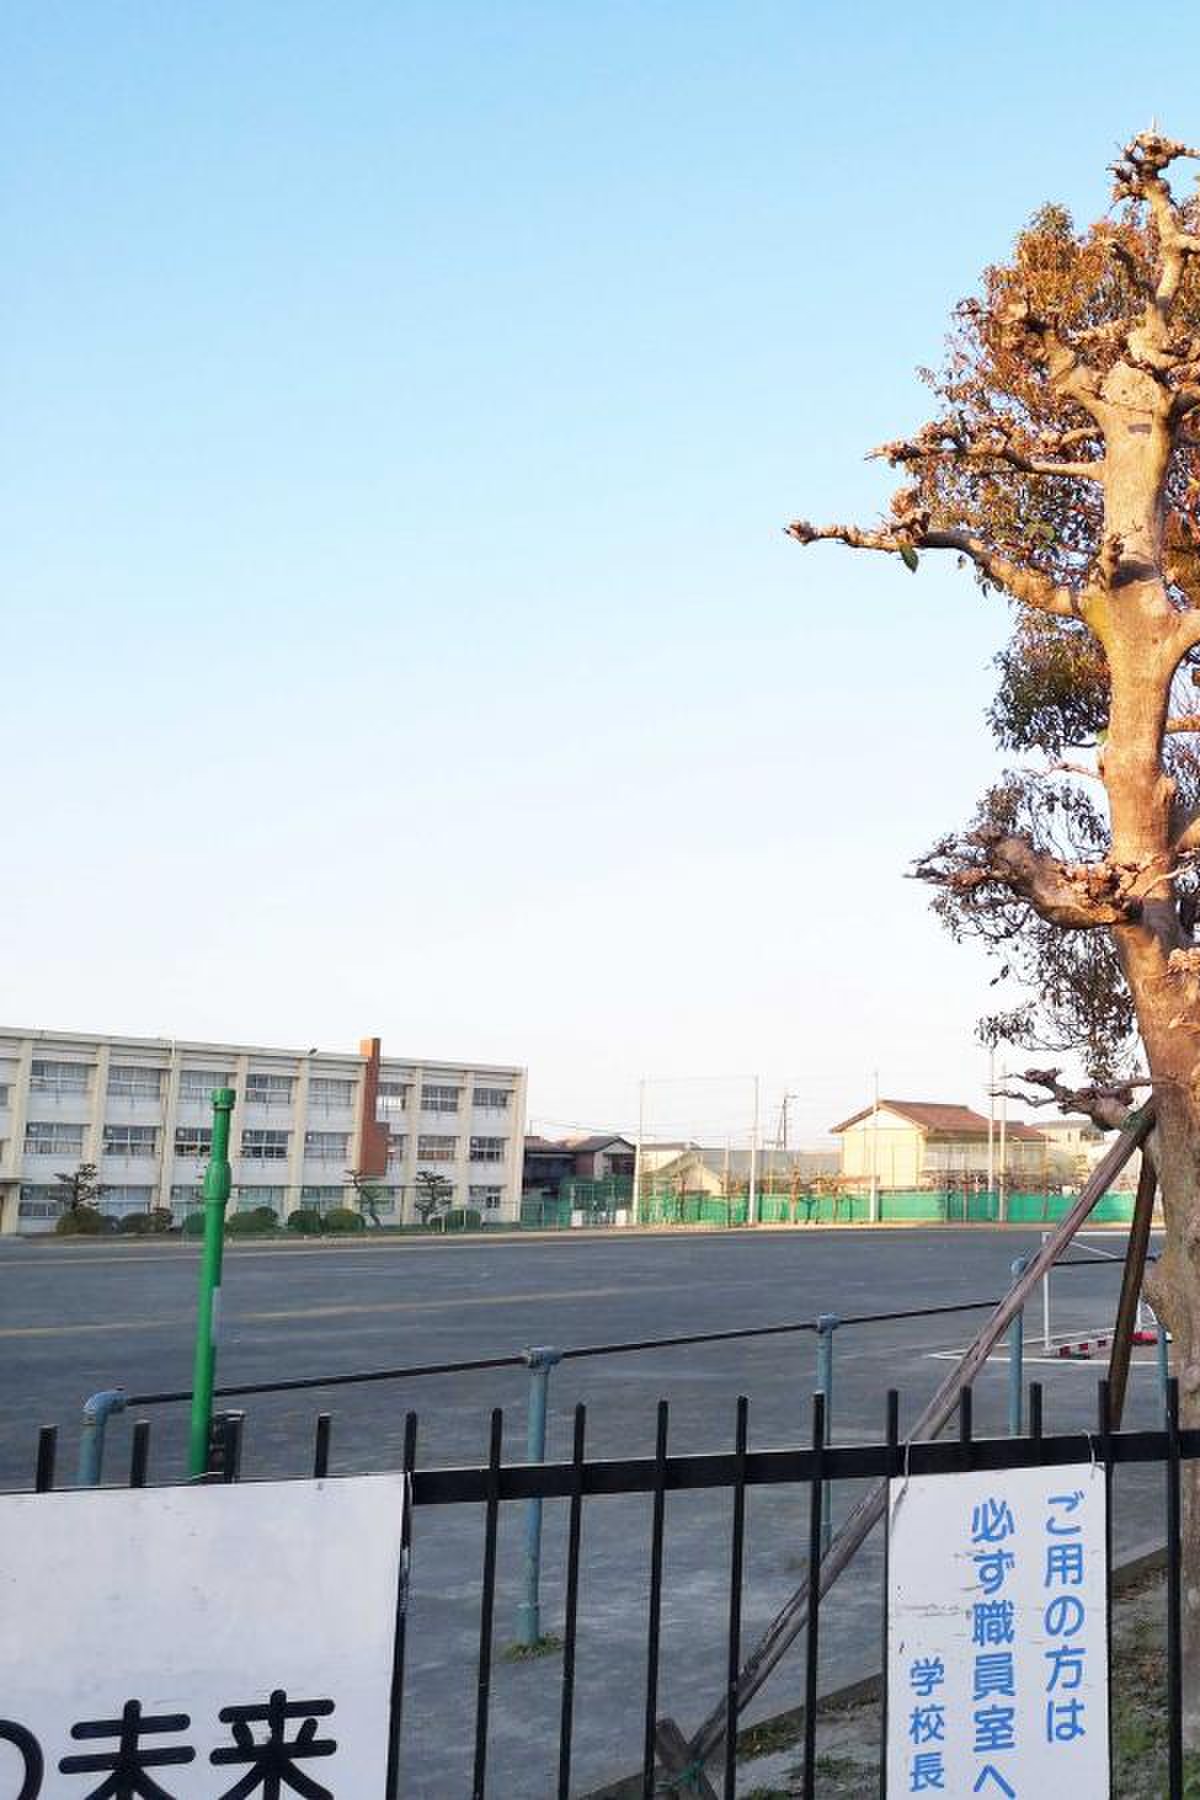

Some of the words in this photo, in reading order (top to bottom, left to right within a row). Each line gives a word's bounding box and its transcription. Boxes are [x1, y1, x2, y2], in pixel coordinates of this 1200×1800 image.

[970, 1497, 1018, 1800] 必ず職員室へ
[1043, 1490, 1088, 1744] ご用の方は
[0, 1690, 337, 1800] 未来
[908, 1657, 946, 1793] 学校長
